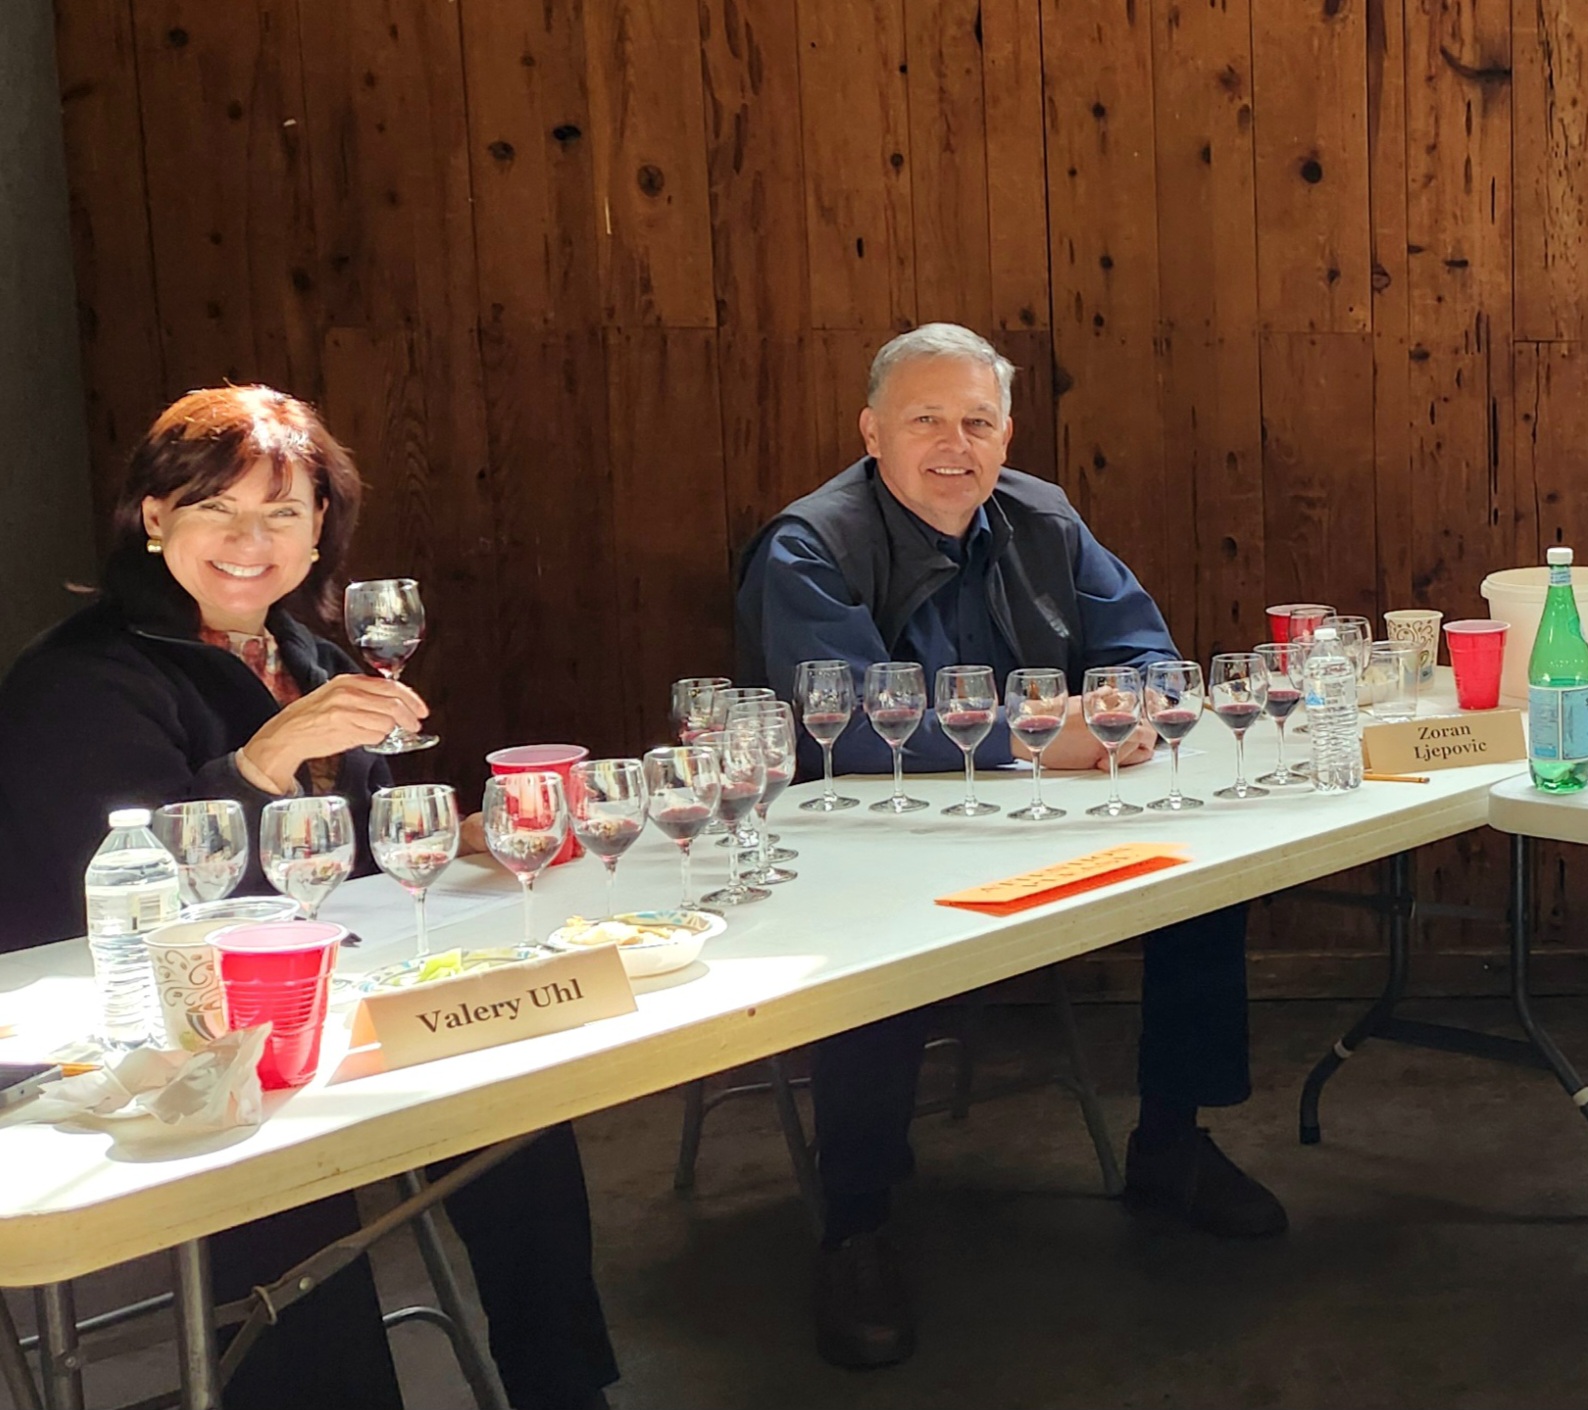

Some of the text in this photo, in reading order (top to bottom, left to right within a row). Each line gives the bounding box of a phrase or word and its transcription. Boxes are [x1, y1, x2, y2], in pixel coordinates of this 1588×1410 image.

[1417, 724, 1472, 741] Zoran
[1413, 738, 1488, 762] Ljepovic
[415, 978, 585, 1034] Valery Uhl
